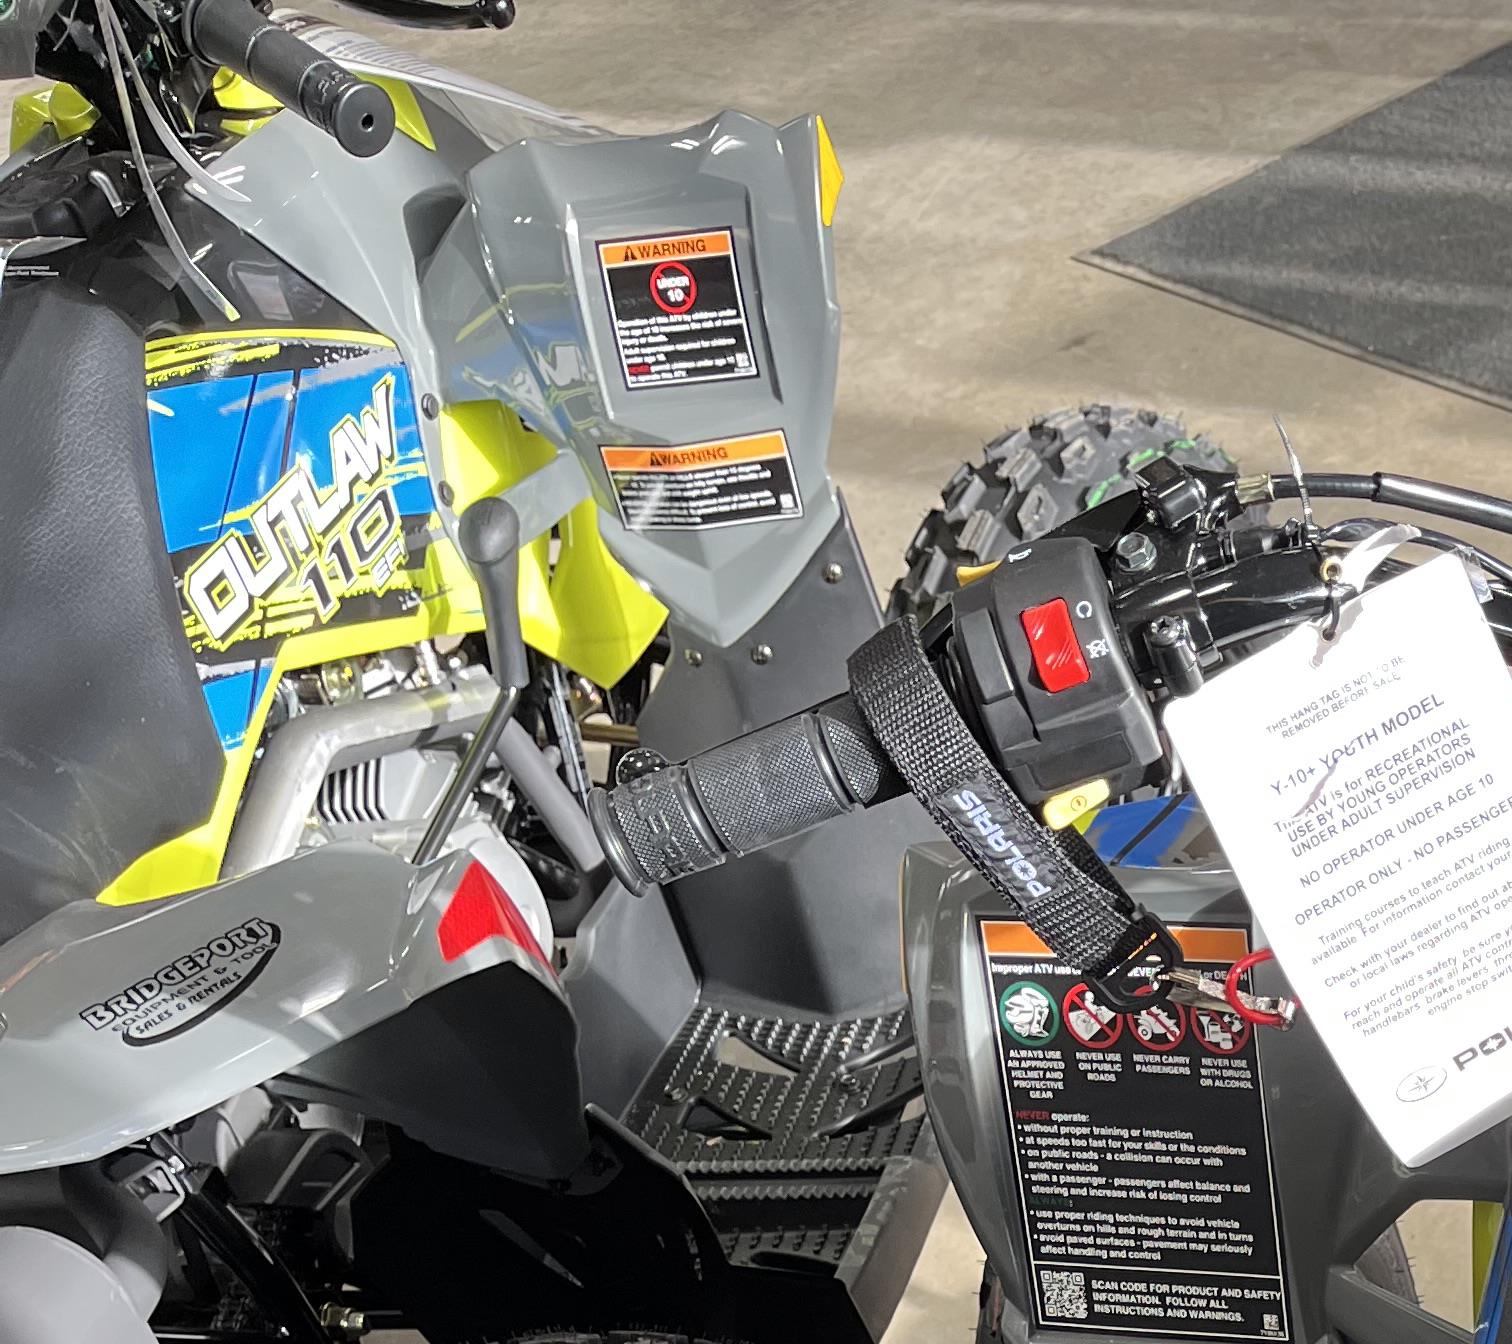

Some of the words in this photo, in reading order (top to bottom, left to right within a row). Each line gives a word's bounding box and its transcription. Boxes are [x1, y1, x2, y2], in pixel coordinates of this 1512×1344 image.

[637, 239, 706, 258] WARNING
[666, 287, 685, 302] 10
[661, 447, 728, 465] WARNING
[186, 376, 394, 645] OUTLAW
[299, 488, 396, 619] 110
[1320, 690, 1340, 705] TAG
[1342, 684, 1351, 694] IS
[1270, 767, 1316, 795] Y-10+
[1380, 693, 1445, 736] MODEL
[1282, 708, 1330, 739] REMOVED
[1329, 789, 1343, 801] is
[1344, 776, 1363, 793] for
[1364, 718, 1470, 781] RECREATIONAL
[1287, 819, 1316, 843] USE
[1315, 807, 1334, 827] BY
[1336, 780, 1387, 813] YOUNG
[1388, 732, 1471, 786] OPERATORS
[1291, 824, 1339, 858] UNDER
[1341, 798, 1383, 832] ADULT
[1385, 747, 1476, 805] SUPERVISION
[952, 790, 1051, 897] POLARIS
[1299, 870, 1321, 888] NO
[1322, 828, 1396, 875] OPERATOR
[1396, 801, 1445, 834] UNDER
[1447, 782, 1476, 808] AGE
[1478, 773, 1494, 788] 10
[1294, 879, 1368, 926] OPERATOR
[1368, 858, 1402, 885] ONLY
[1413, 842, 1435, 861] NO
[1317, 918, 1363, 945] Training
[1364, 894, 1407, 922] courses
[1407, 887, 1420, 897] to
[1420, 868, 1452, 890] teach
[1454, 853, 1475, 873] ATV
[1478, 837, 1511, 859] riding
[80, 917, 273, 1031] BRIDGEPORT
[111, 971, 213, 1033] EQUIPMENT
[135, 1008, 174, 1035] SALES
[187, 970, 242, 1008] RENTALS
[1132, 1053, 1161, 1064] NEVER
[1161, 1054, 1191, 1065] CARRY
[1134, 1063, 1191, 1076] PASSENGERS
[1199, 1067, 1221, 1077] WITH
[1222, 1068, 1251, 1079] DRUGS
[1201, 1057, 1229, 1067] NEVER
[1229, 1058, 1247, 1068] USE
[1199, 1077, 1212, 1087] OR
[1213, 1078, 1254, 1089] ALCOHOL
[1090, 1278, 1119, 1291] SCAN
[1119, 1280, 1148, 1293] CODE
[1148, 1282, 1170, 1294] FOR
[1170, 1283, 1219, 1298] PRODUCT
[1219, 1287, 1242, 1299] AND
[1242, 1288, 1282, 1302] SAFETY
[1093, 1301, 1164, 1319] INSTRUCTIONS
[1165, 1307, 1187, 1318] AND
[1165, 1295, 1207, 1309] FOLLOW
[1208, 1298, 1228, 1309] ALL
